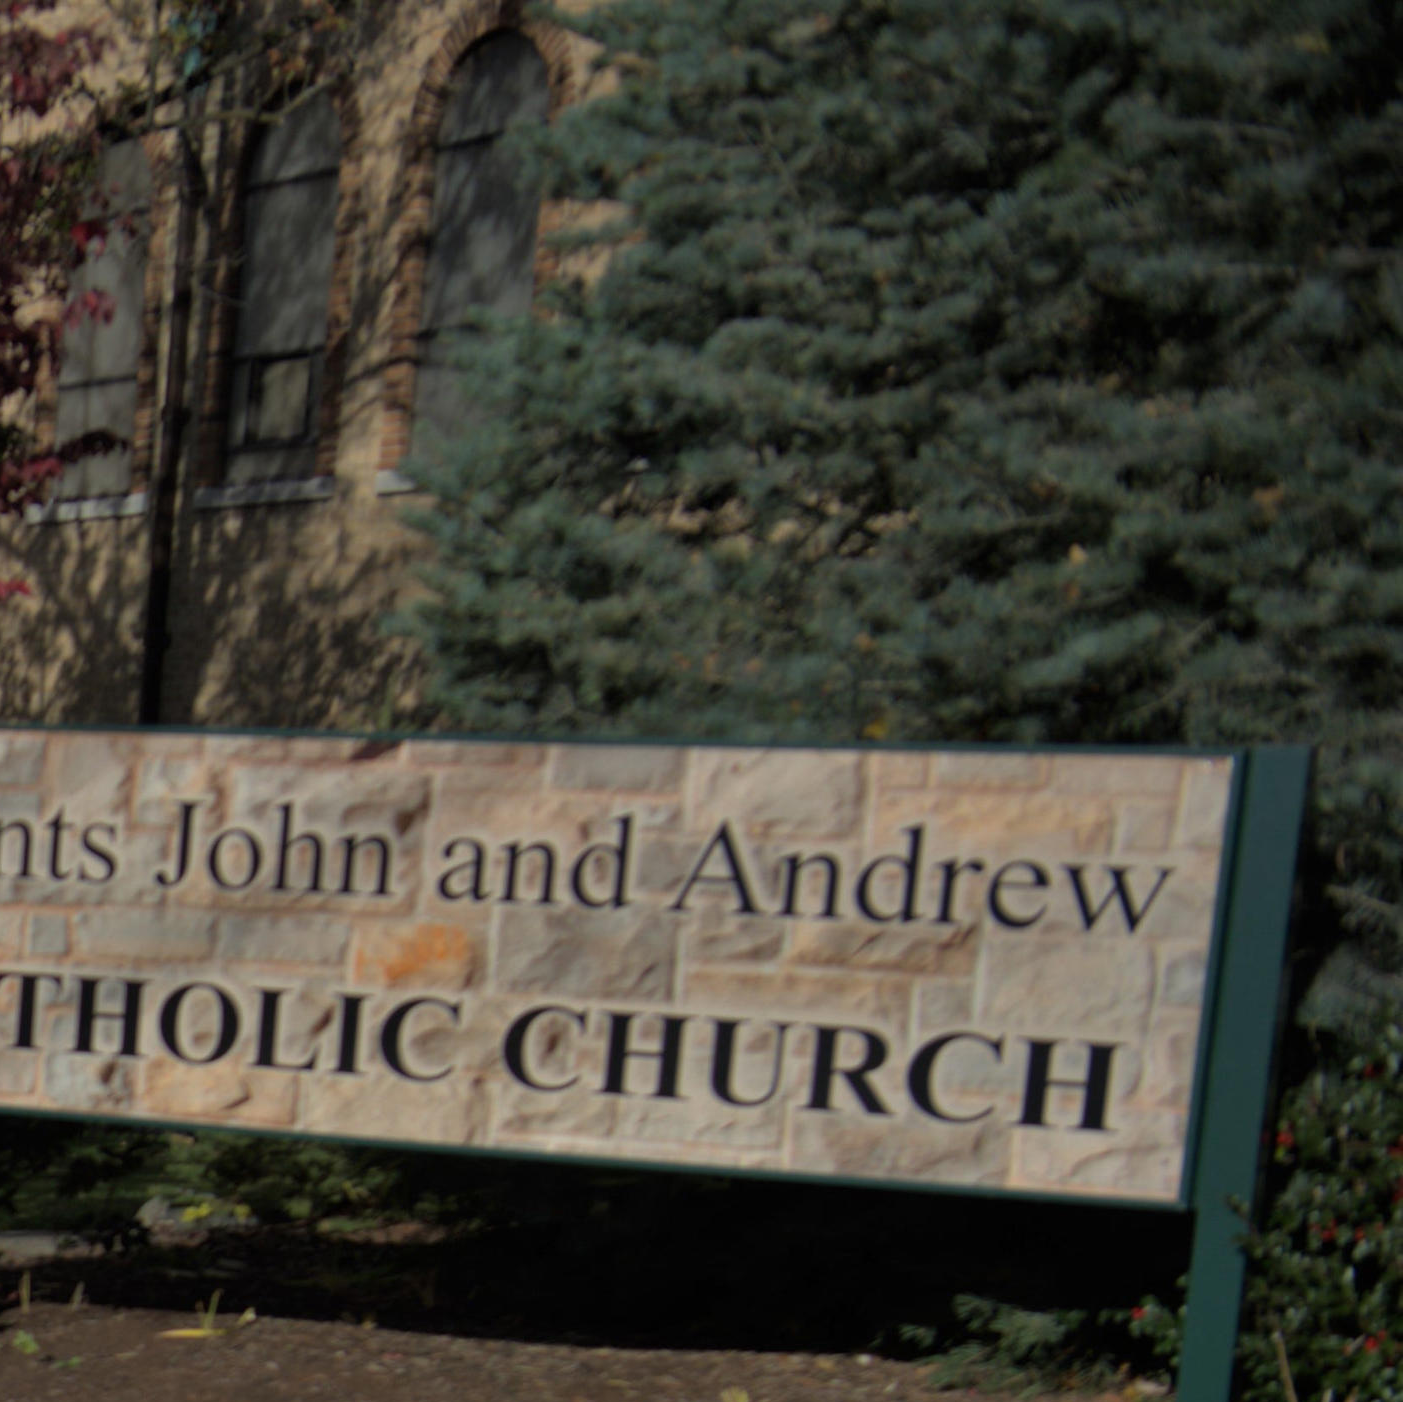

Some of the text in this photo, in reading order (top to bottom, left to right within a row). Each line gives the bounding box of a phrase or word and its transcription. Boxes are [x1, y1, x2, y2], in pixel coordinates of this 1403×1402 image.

[155, 800, 396, 896] John
[436, 814, 633, 910] and
[669, 819, 1175, 934] Andrew
[502, 1005, 1123, 1133] CHURCH
